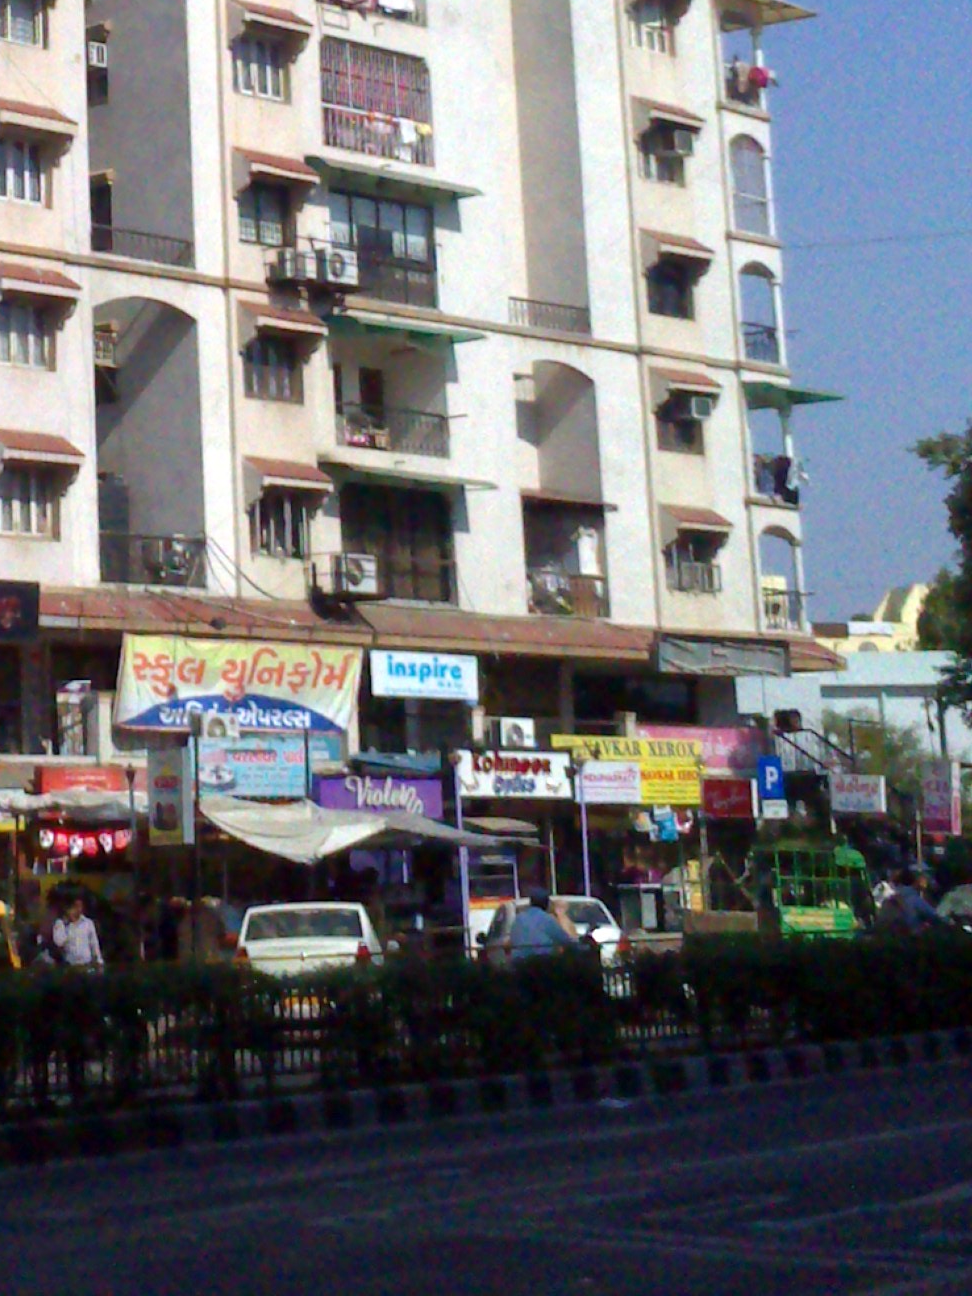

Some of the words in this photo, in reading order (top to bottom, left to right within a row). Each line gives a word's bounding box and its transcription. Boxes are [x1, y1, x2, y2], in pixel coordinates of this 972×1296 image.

[387, 654, 462, 683] inspire
[648, 741, 695, 757] XEROX
[765, 765, 779, 791] P
